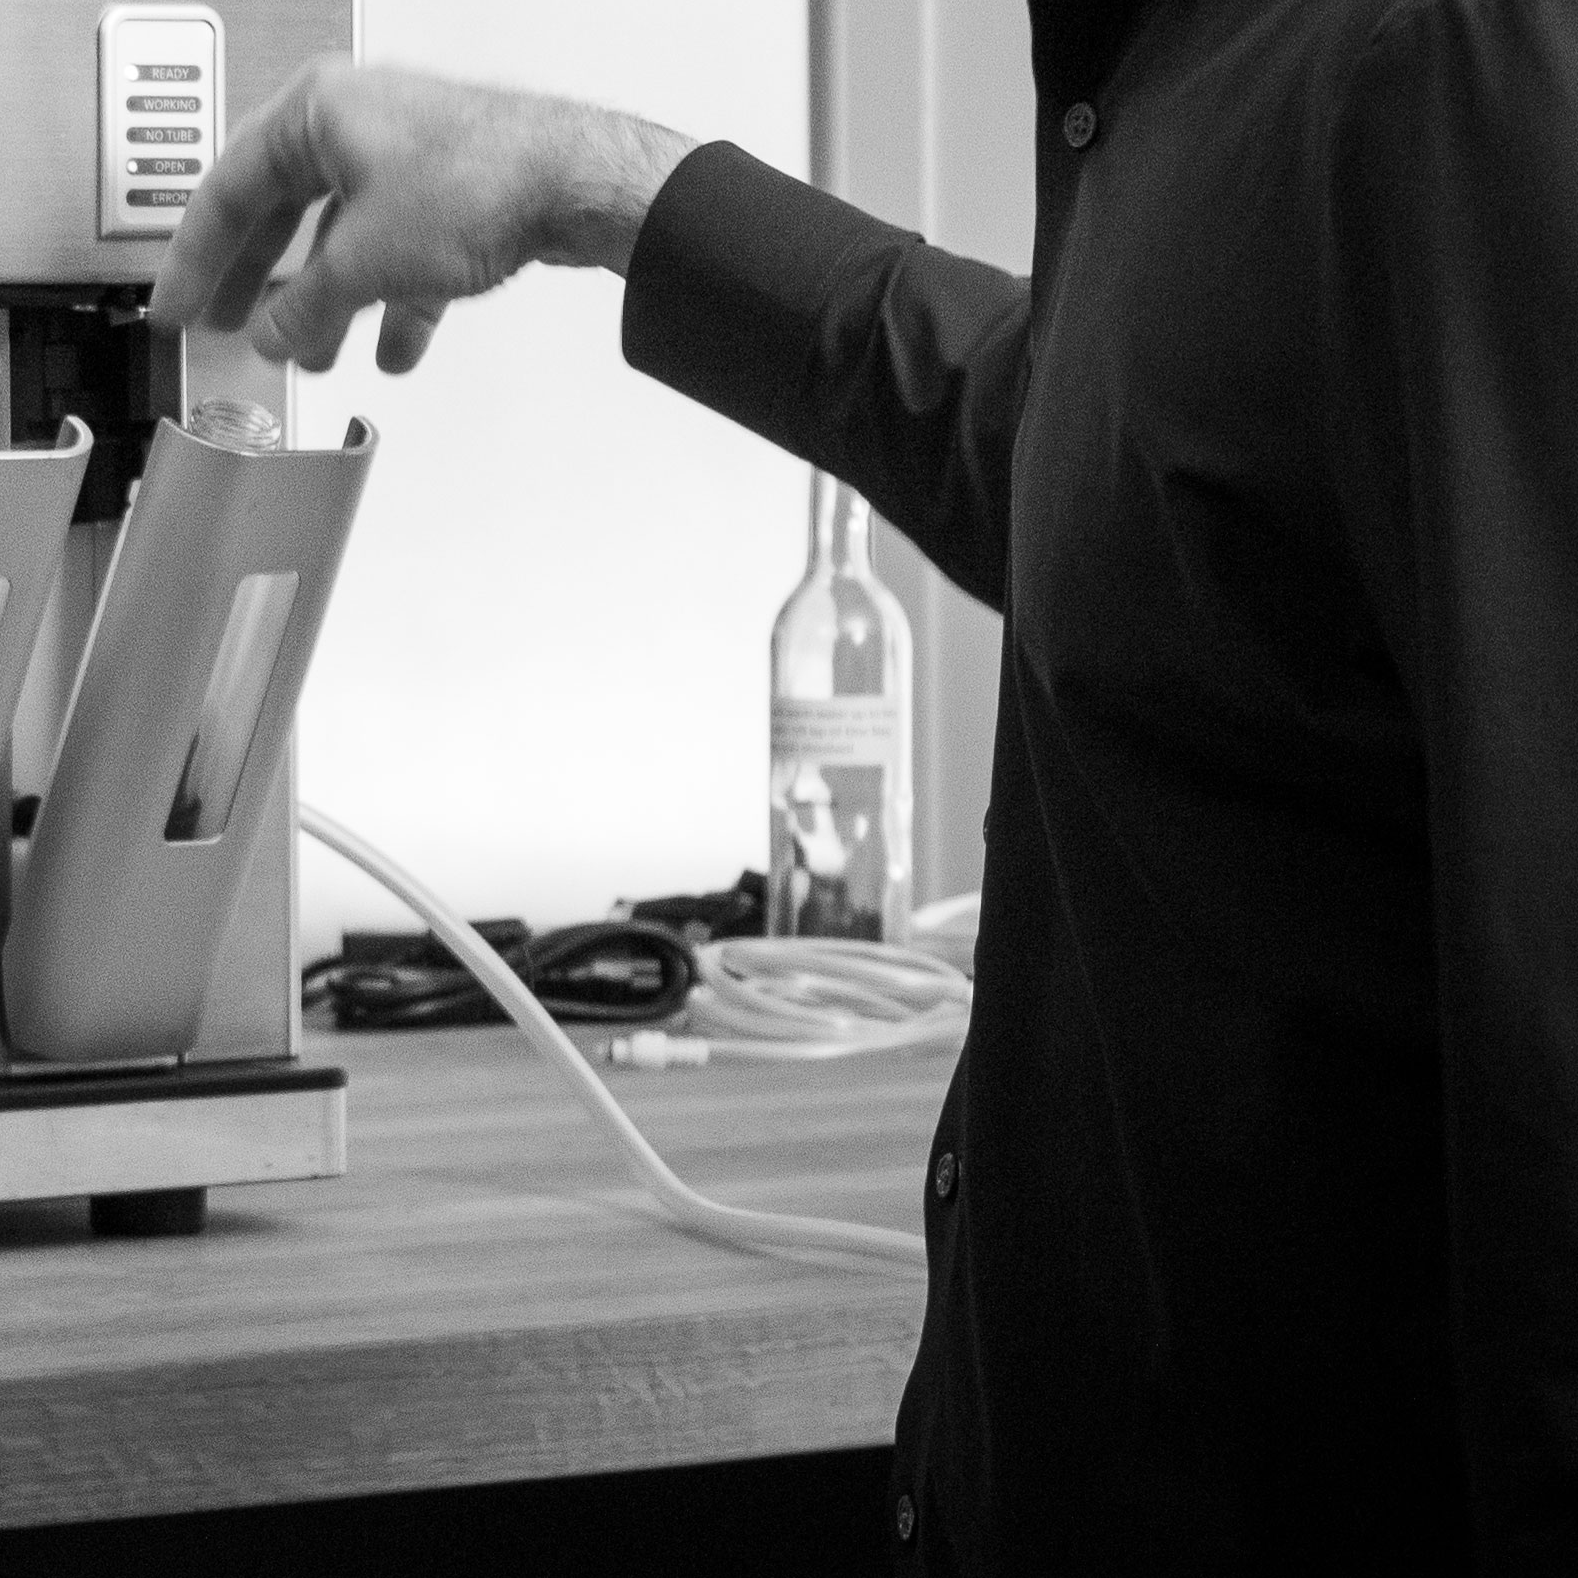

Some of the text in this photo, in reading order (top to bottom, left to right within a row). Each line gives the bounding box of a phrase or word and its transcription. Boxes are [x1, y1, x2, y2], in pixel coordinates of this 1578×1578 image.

[152, 67, 189, 80] READY
[144, 99, 197, 111] WORKING
[146, 129, 194, 142] NO TUBE
[155, 161, 186, 173] OPEN
